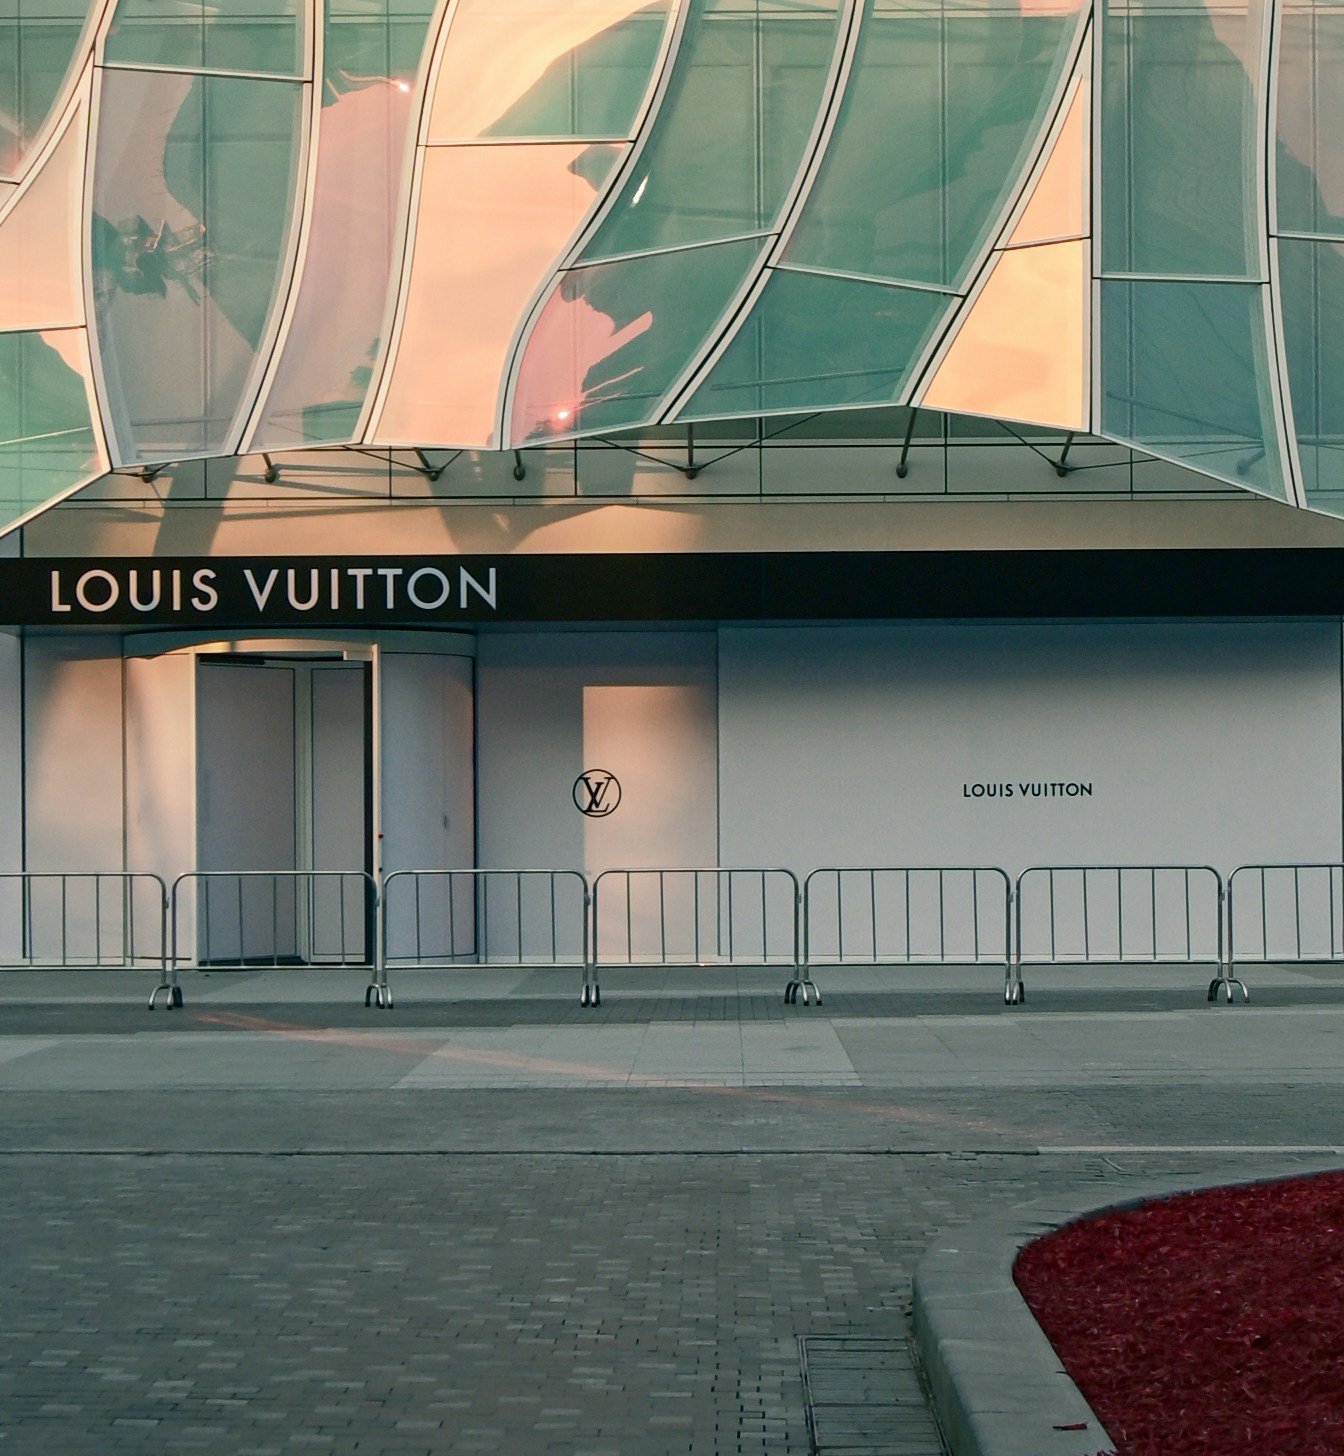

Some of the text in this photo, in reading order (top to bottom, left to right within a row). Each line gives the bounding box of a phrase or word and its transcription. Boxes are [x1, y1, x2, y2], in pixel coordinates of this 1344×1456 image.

[51, 567, 498, 613] LOUIS VUITTON
[963, 782, 1093, 798] LOUIS VUITTON
